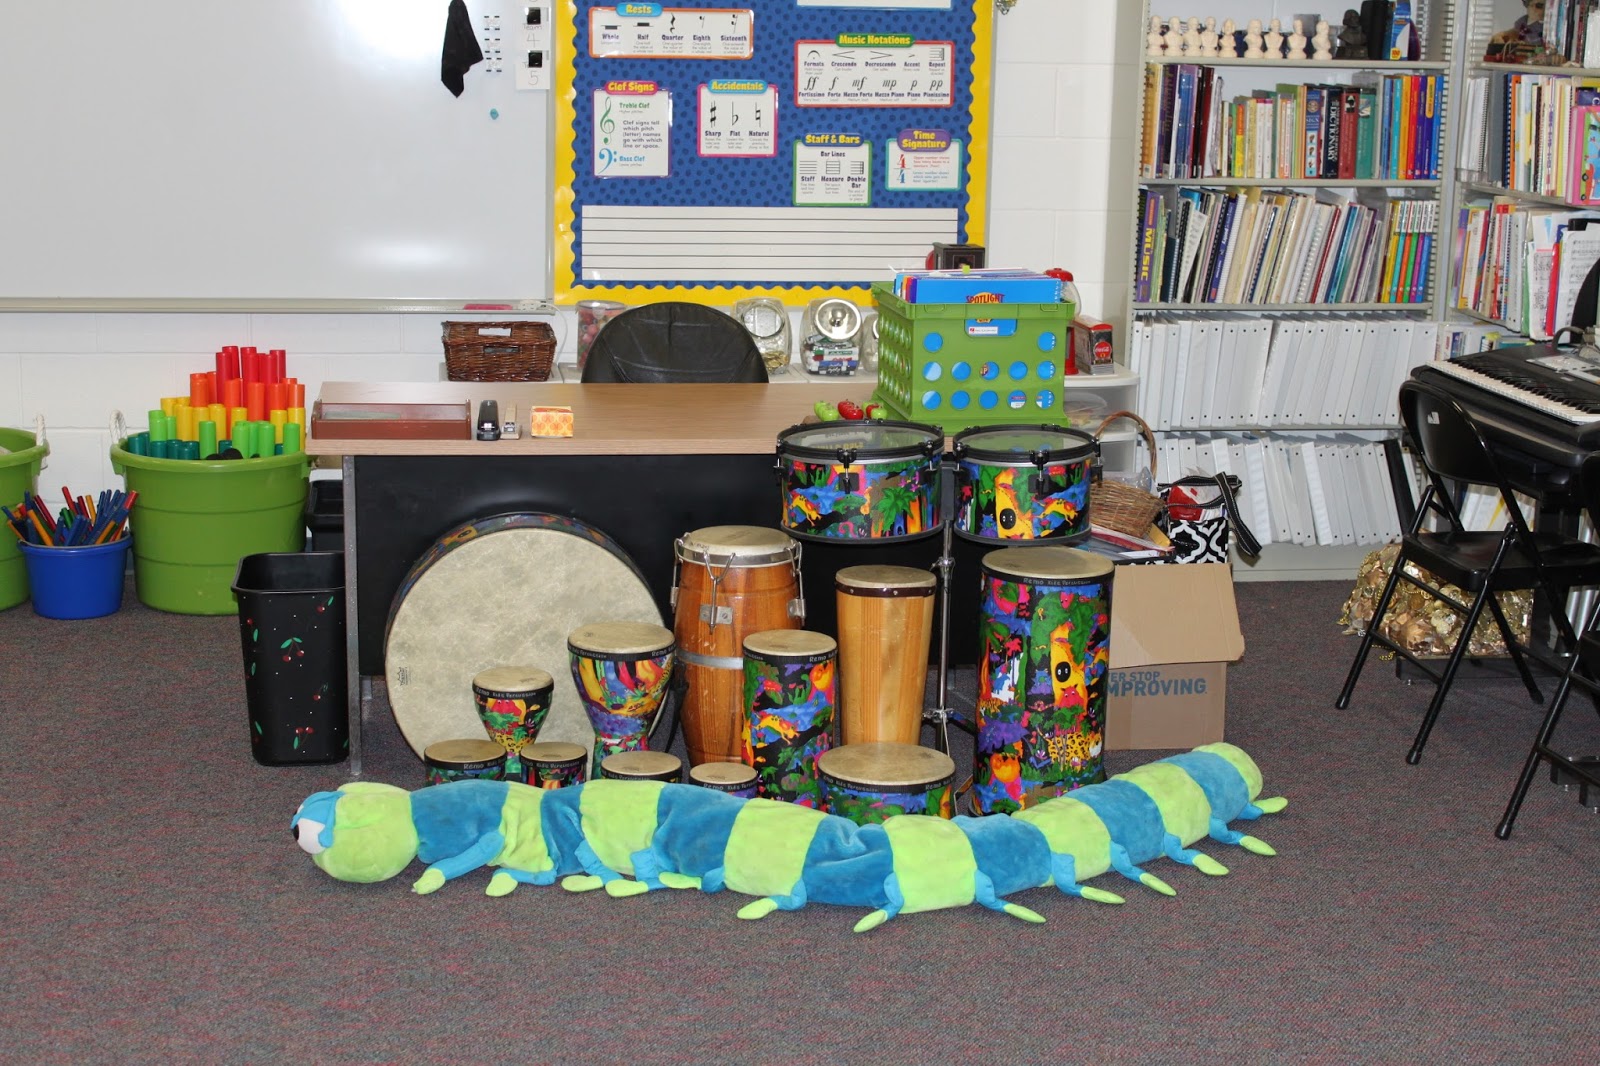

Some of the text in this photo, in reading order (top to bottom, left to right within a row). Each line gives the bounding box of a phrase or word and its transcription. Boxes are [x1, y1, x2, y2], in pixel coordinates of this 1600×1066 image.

[626, 4, 652, 14] Rests
[527, 33, 540, 48] 4
[840, 35, 911, 45] Music Notations
[528, 70, 538, 86] 5
[608, 82, 655, 93] Clef Signs
[712, 81, 764, 90] Accidentals
[913, 131, 935, 139] Time
[1328, 106, 1337, 160] DICTIONARY
[806, 134, 860, 143] Staff & Bars
[902, 139, 946, 149] Signature
[897, 154, 905, 168] 4
[896, 170, 905, 183] 4
[1141, 228, 1152, 281] MUSIC
[966, 293, 1005, 303] SPOTLIGHT
[1130, 672, 1160, 682] STOP
[1107, 678, 1207, 697] MPROVING.
